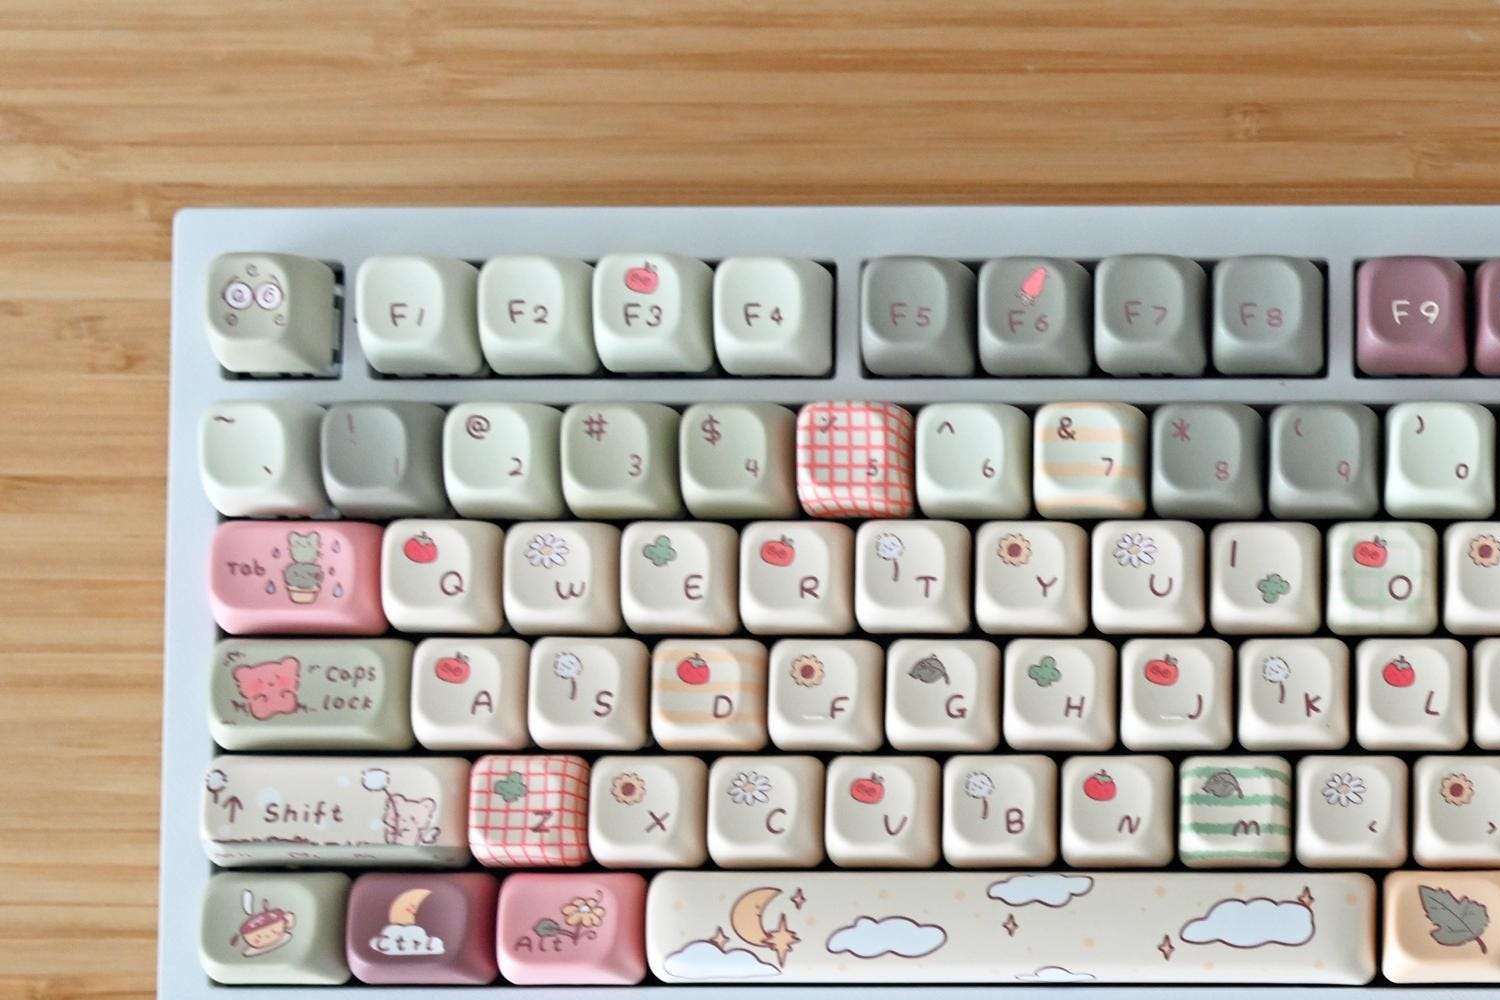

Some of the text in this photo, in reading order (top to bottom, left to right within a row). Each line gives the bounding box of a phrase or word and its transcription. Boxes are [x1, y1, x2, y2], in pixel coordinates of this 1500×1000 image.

[390, 304, 425, 327] F1
[508, 300, 549, 325] F2
[623, 303, 663, 327] F3
[743, 303, 783, 327] F4
[891, 303, 933, 328] F5
[1008, 311, 1050, 334] F6
[1125, 302, 1169, 327] F7
[1239, 304, 1284, 328] F8
[1392, 301, 1440, 325] F9
[465, 414, 491, 440] @
[583, 414, 608, 440] #
[701, 414, 722, 445] $
[1057, 416, 1076, 440] &
[508, 455, 523, 476] 2
[629, 454, 643, 476] 3
[745, 459, 760, 477] 4
[865, 458, 878, 477] 5
[982, 458, 996, 479] 6
[1102, 457, 1114, 477] 7
[1215, 460, 1230, 481] 8
[1337, 461, 1350, 482] 9
[227, 561, 266, 578] Tab
[440, 571, 464, 596] Q
[683, 575, 703, 600] E
[799, 575, 820, 600] R
[916, 575, 937, 598] T
[1036, 576, 1056, 598] Y
[1149, 575, 1173, 598] U
[1388, 575, 1412, 600] O
[470, 691, 493, 714] A
[594, 691, 614, 716] S
[713, 695, 733, 718] D
[829, 696, 848, 719] F
[945, 695, 967, 720] G
[1065, 696, 1084, 718] H
[1189, 694, 1204, 720] J
[1304, 694, 1322, 717] K
[1424, 691, 1440, 716] L
[264, 800, 343, 825] Shift
[531, 811, 551, 832] Z
[646, 811, 670, 832] X
[767, 808, 786, 834] C
[1007, 808, 1024, 834] B
[884, 815, 907, 836] V
[1118, 815, 1139, 835] N
[376, 932, 435, 953] Ctrl
[515, 934, 563, 954] Alt
